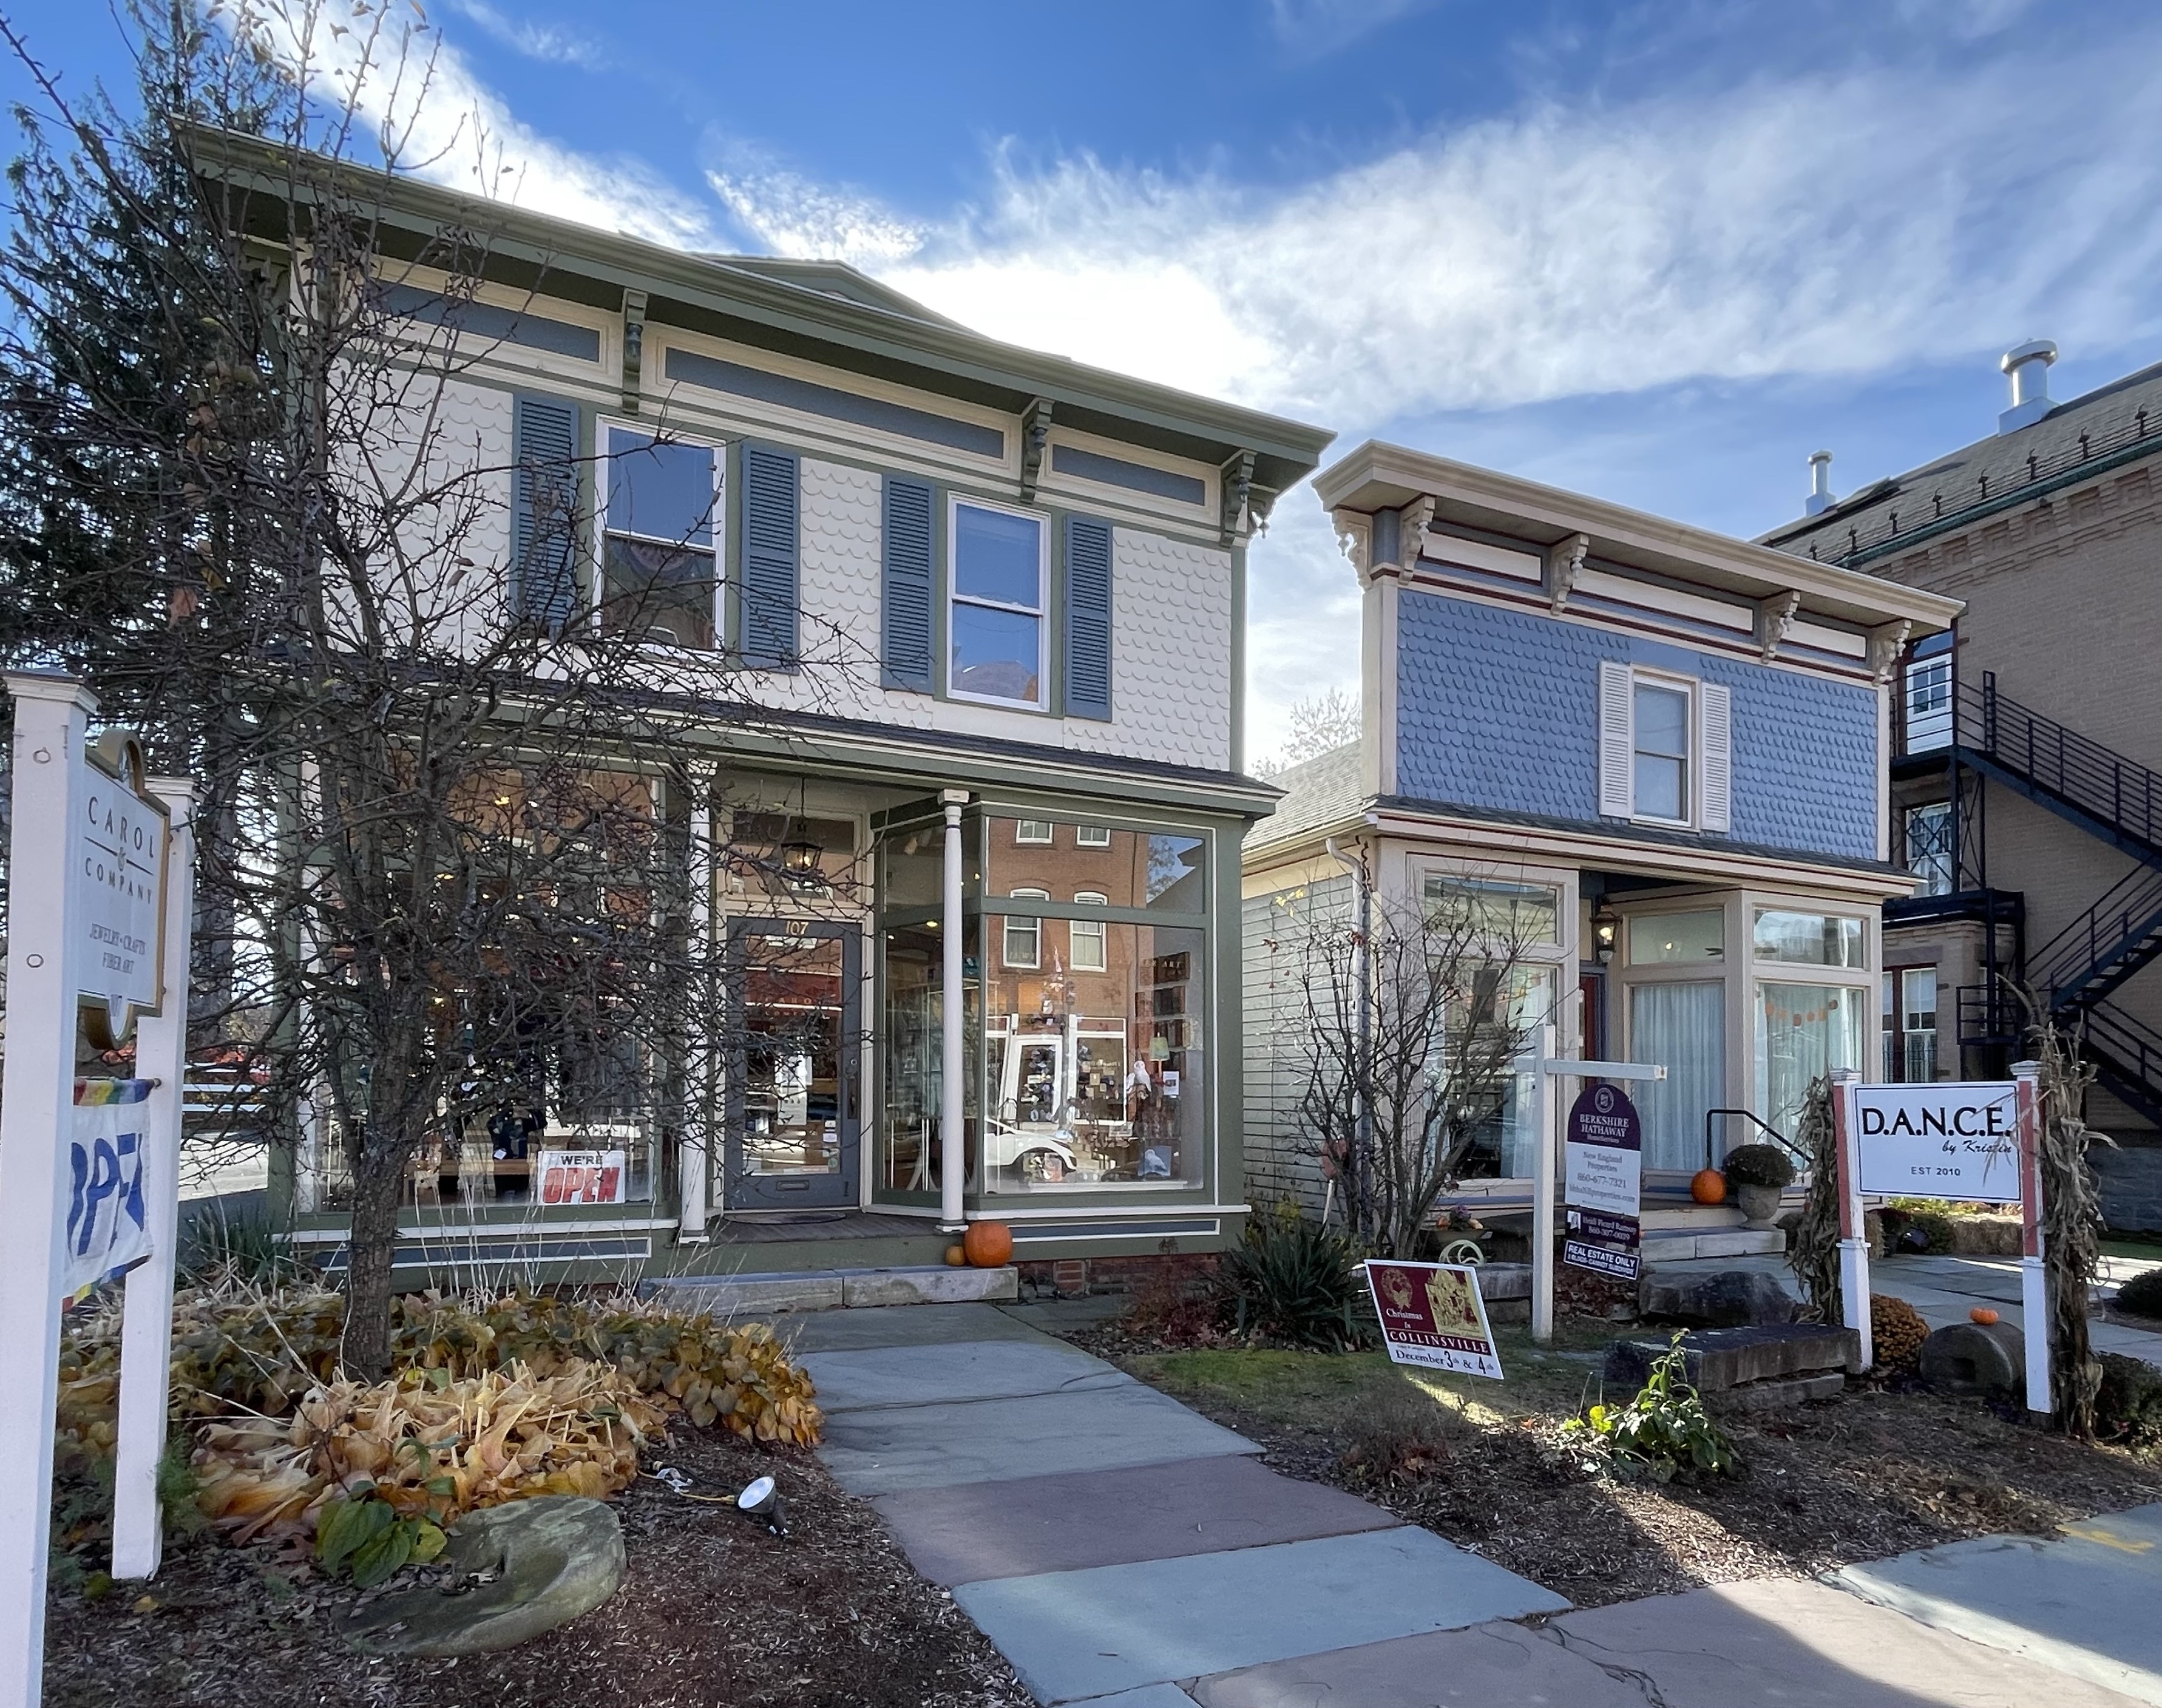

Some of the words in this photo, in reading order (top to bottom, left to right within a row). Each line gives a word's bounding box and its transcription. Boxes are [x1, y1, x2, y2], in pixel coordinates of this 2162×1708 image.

[88, 796, 154, 858] CAROL
[85, 857, 151, 904] COMPANY
[785, 921, 809, 936] 107
[1579, 1114, 1629, 1128] BERKSHIRE
[1581, 1123, 1627, 1137] HATHAWAY
[1942, 1140, 1956, 1156] by
[560, 1155, 603, 1165] WE'RE
[1911, 1167, 1931, 1175] EST
[1936, 1167, 1961, 1176] 2010
[542, 1167, 620, 1204] OPEN
[1577, 1172, 1626, 1188] 860-677-7321
[1568, 1244, 1586, 1256] REAL
[1587, 1250, 1614, 1263] ESTATE
[1615, 1256, 1635, 1267] ONLY
[1386, 1308, 1423, 1320] Christmas
[1389, 1330, 1488, 1353] COLLINSVILLE
[1395, 1349, 1444, 1365] December
[1462, 1360, 1473, 1369] &
